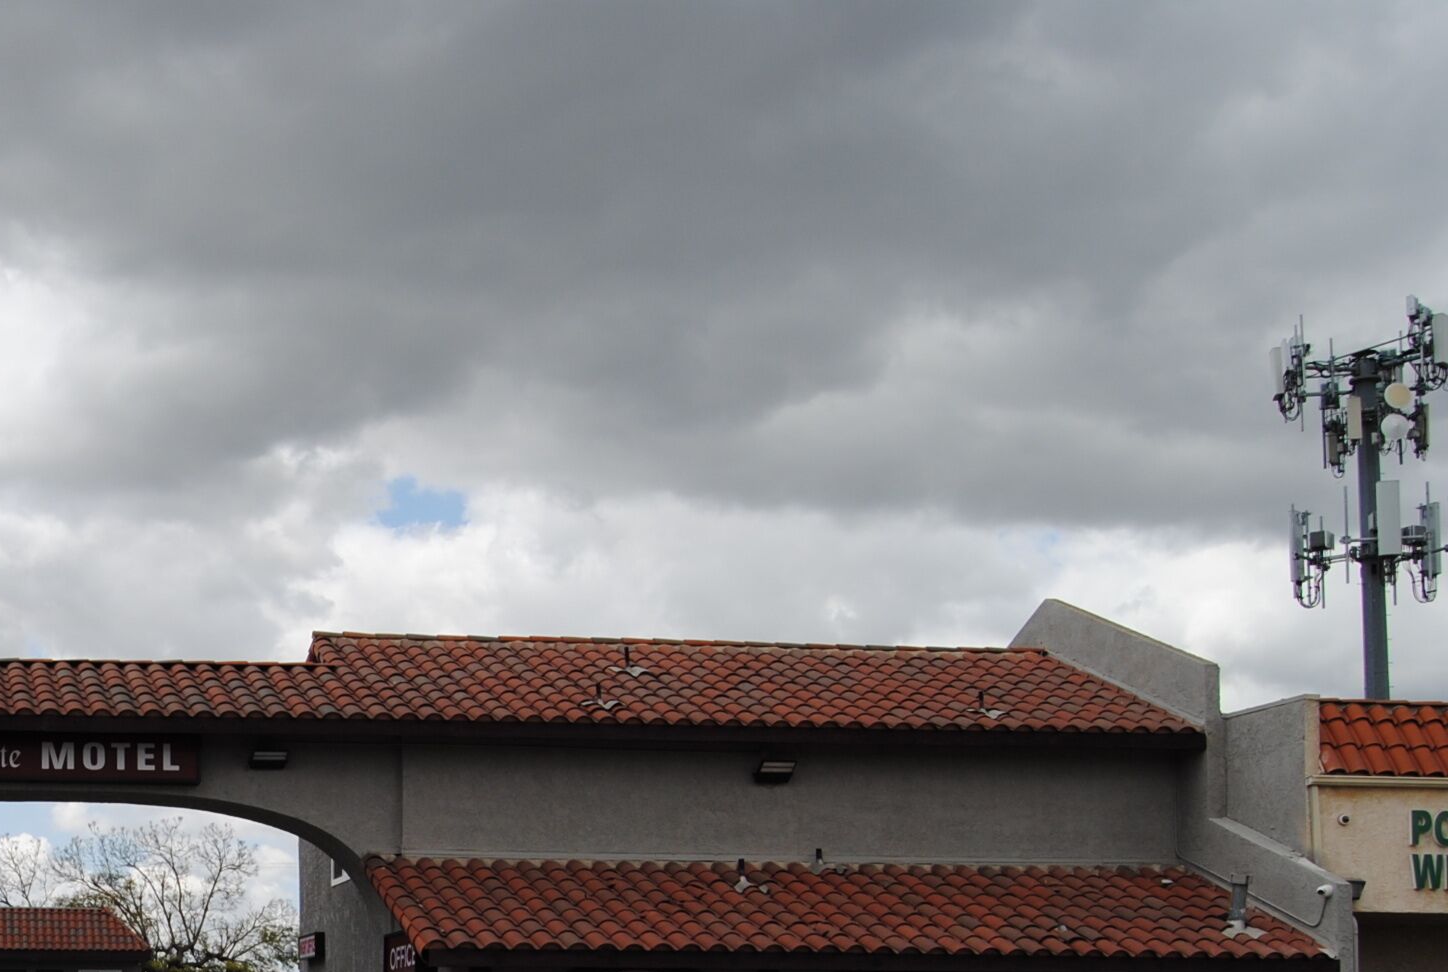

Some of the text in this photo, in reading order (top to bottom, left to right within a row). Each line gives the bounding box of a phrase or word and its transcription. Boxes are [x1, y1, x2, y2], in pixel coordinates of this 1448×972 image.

[41, 742, 181, 771] MOTEL
[1410, 854, 1448, 892] W
[390, 944, 416, 970] OFFICE
